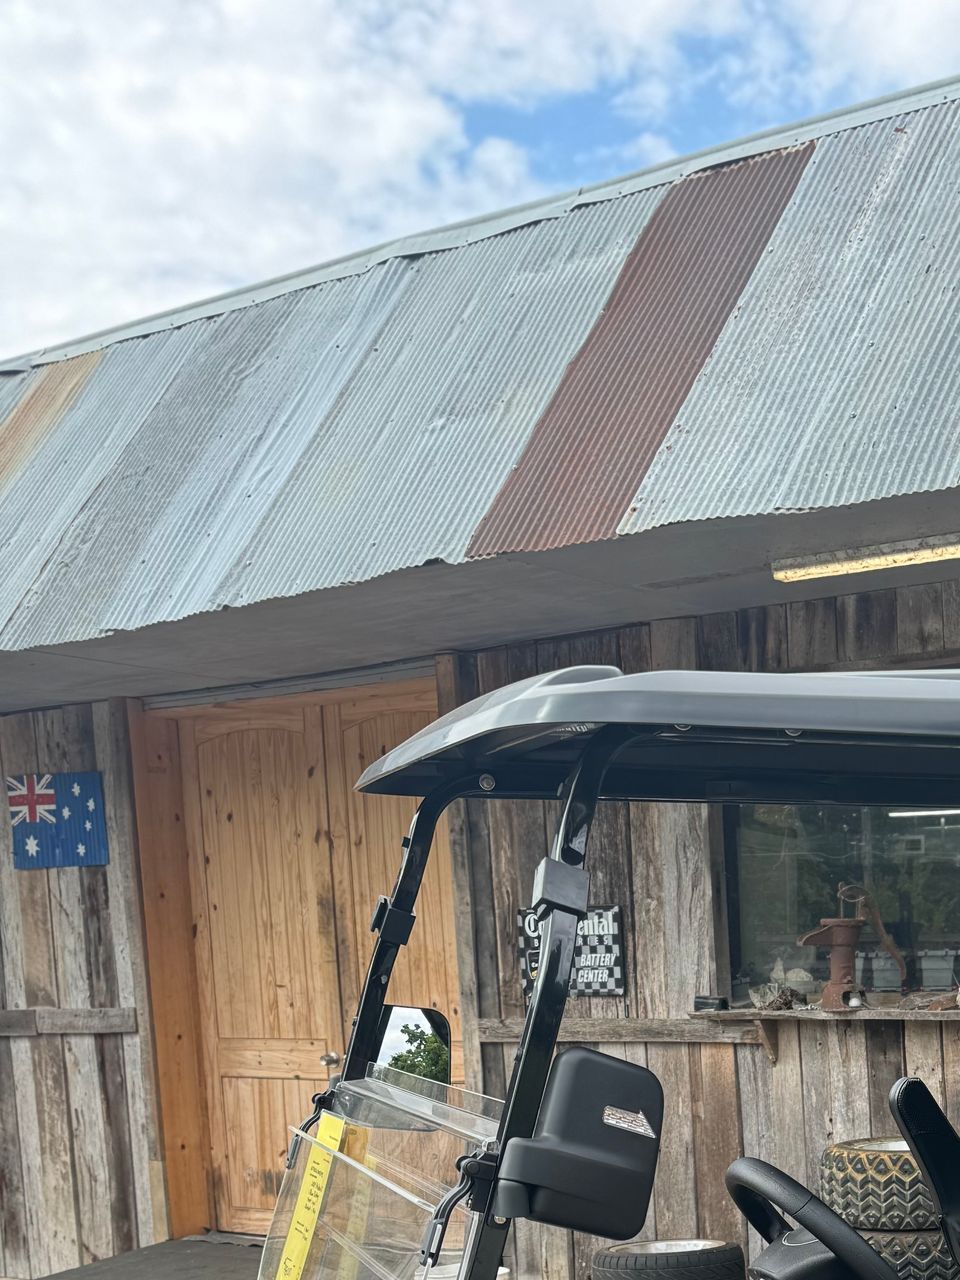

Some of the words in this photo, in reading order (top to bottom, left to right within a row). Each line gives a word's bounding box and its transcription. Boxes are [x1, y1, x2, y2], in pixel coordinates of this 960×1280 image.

[525, 910, 615, 937] Coental
[580, 953, 616, 967] BATTERY
[577, 968, 609, 982] CENTER
